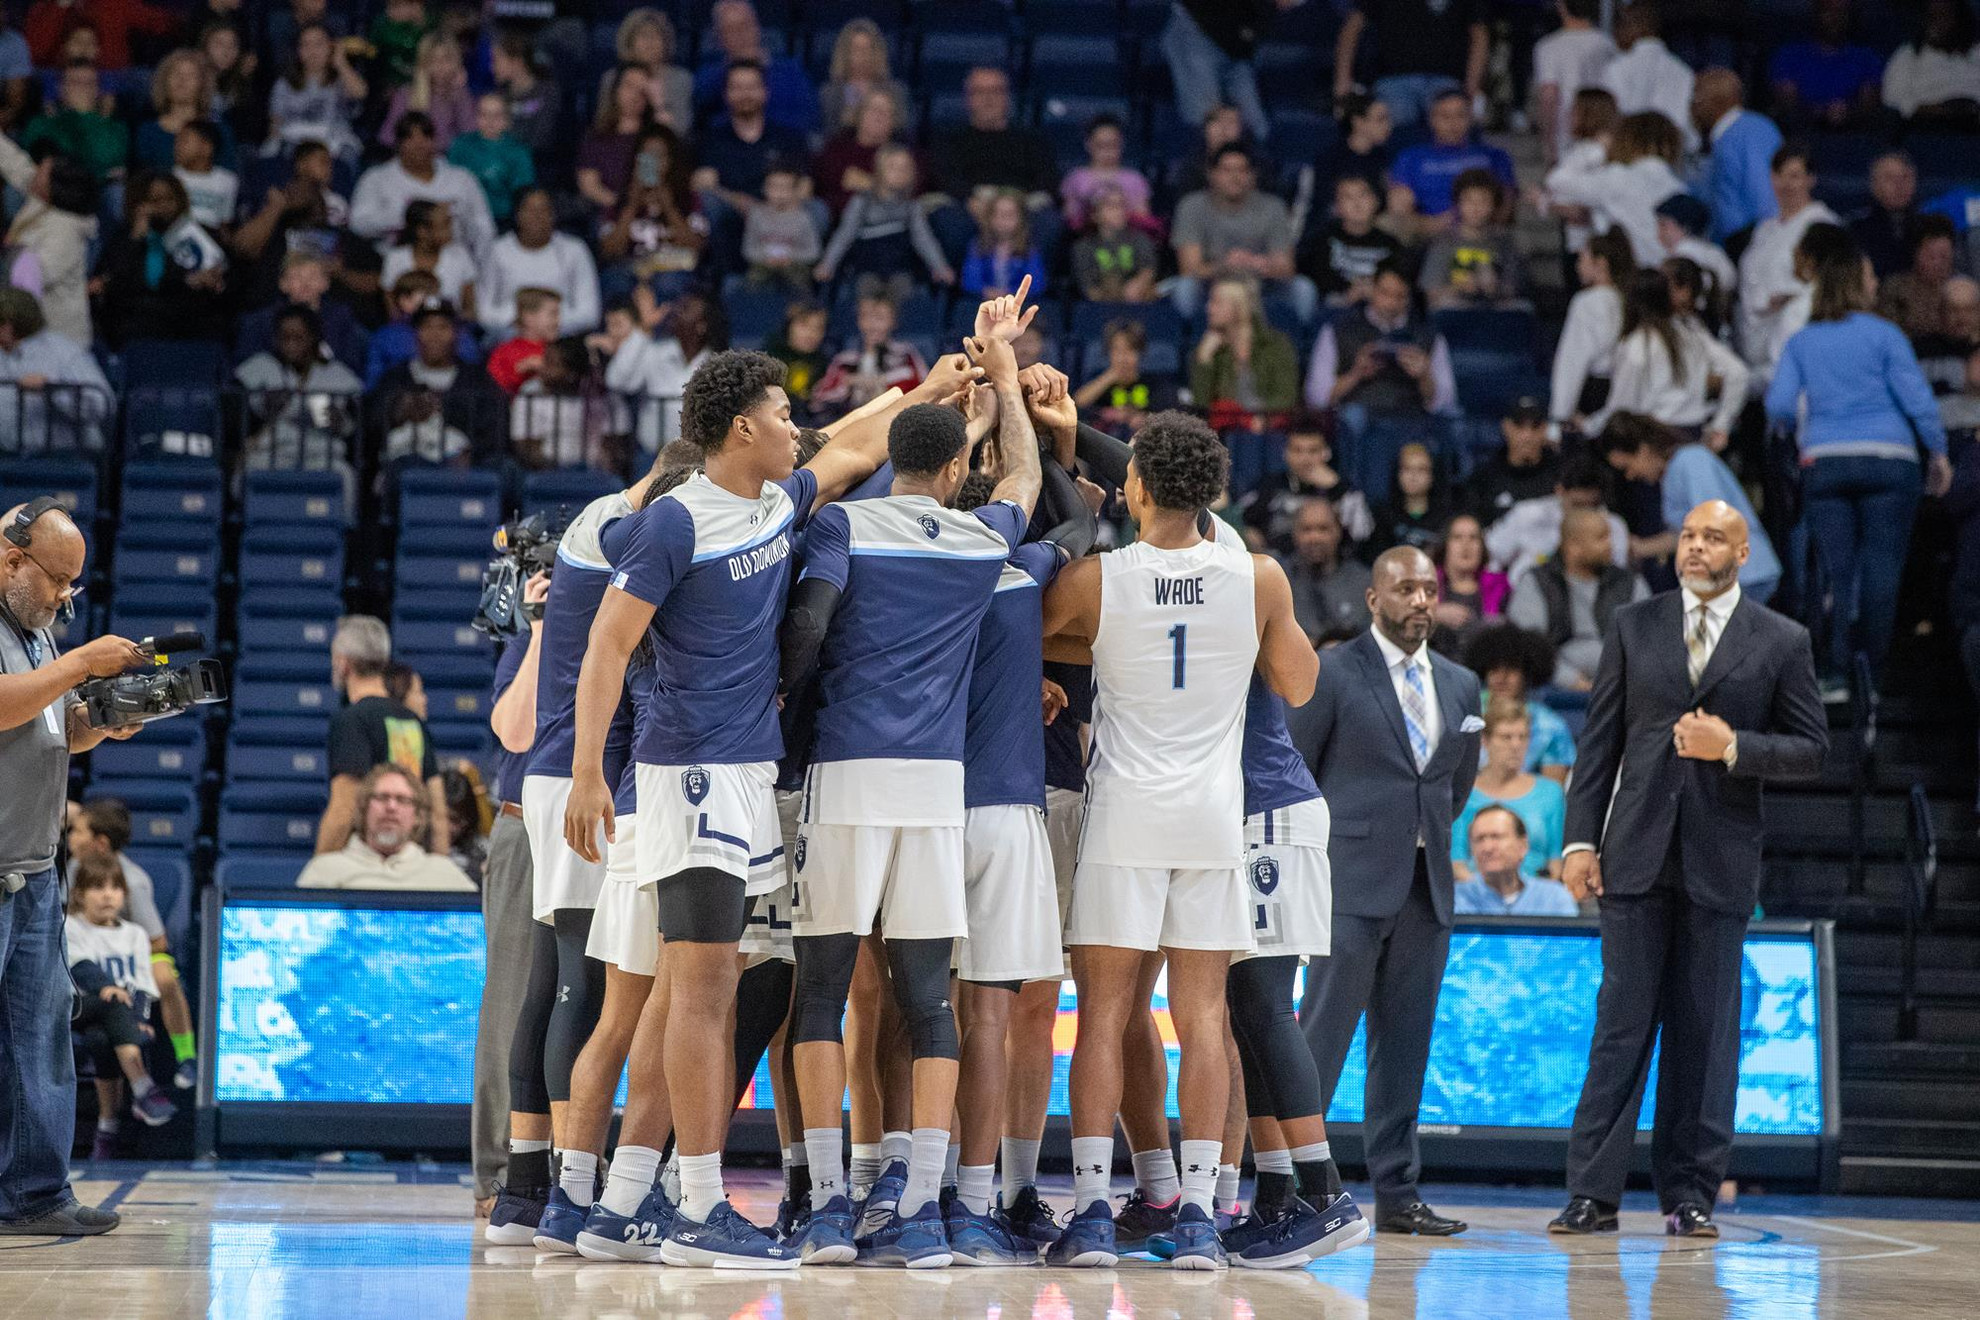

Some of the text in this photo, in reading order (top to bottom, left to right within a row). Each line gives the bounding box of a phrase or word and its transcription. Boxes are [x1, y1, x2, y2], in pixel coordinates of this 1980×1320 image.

[728, 531, 790, 581] OLD DOMINION
[1154, 577, 1205, 605] WADE
[1167, 623, 1187, 690] 1
[624, 1221, 663, 1246] 22
